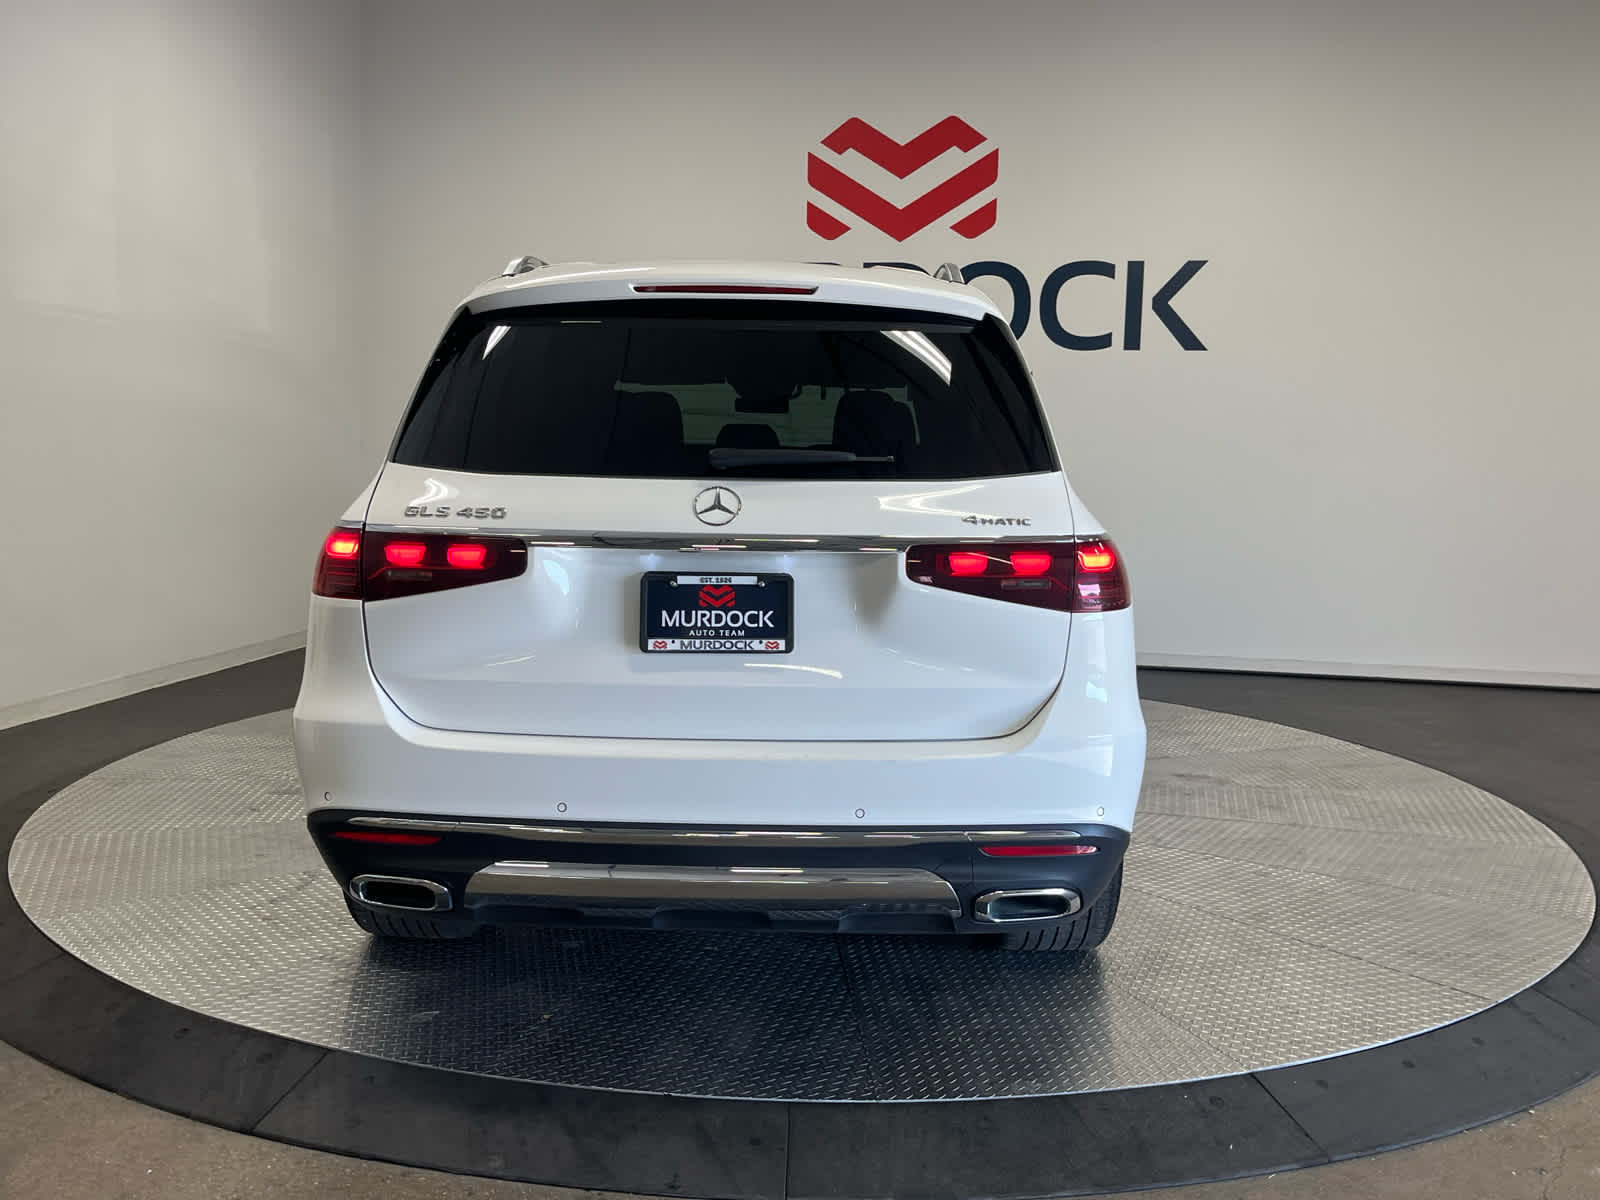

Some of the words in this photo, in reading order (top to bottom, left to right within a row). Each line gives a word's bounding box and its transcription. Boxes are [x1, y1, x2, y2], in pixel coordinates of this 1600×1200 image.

[404, 506, 450, 517] GLS
[456, 507, 505, 519] 450
[961, 516, 1031, 526] 4MATIC
[661, 610, 774, 628] MURDOCK
[680, 640, 755, 650] MURDOCK
